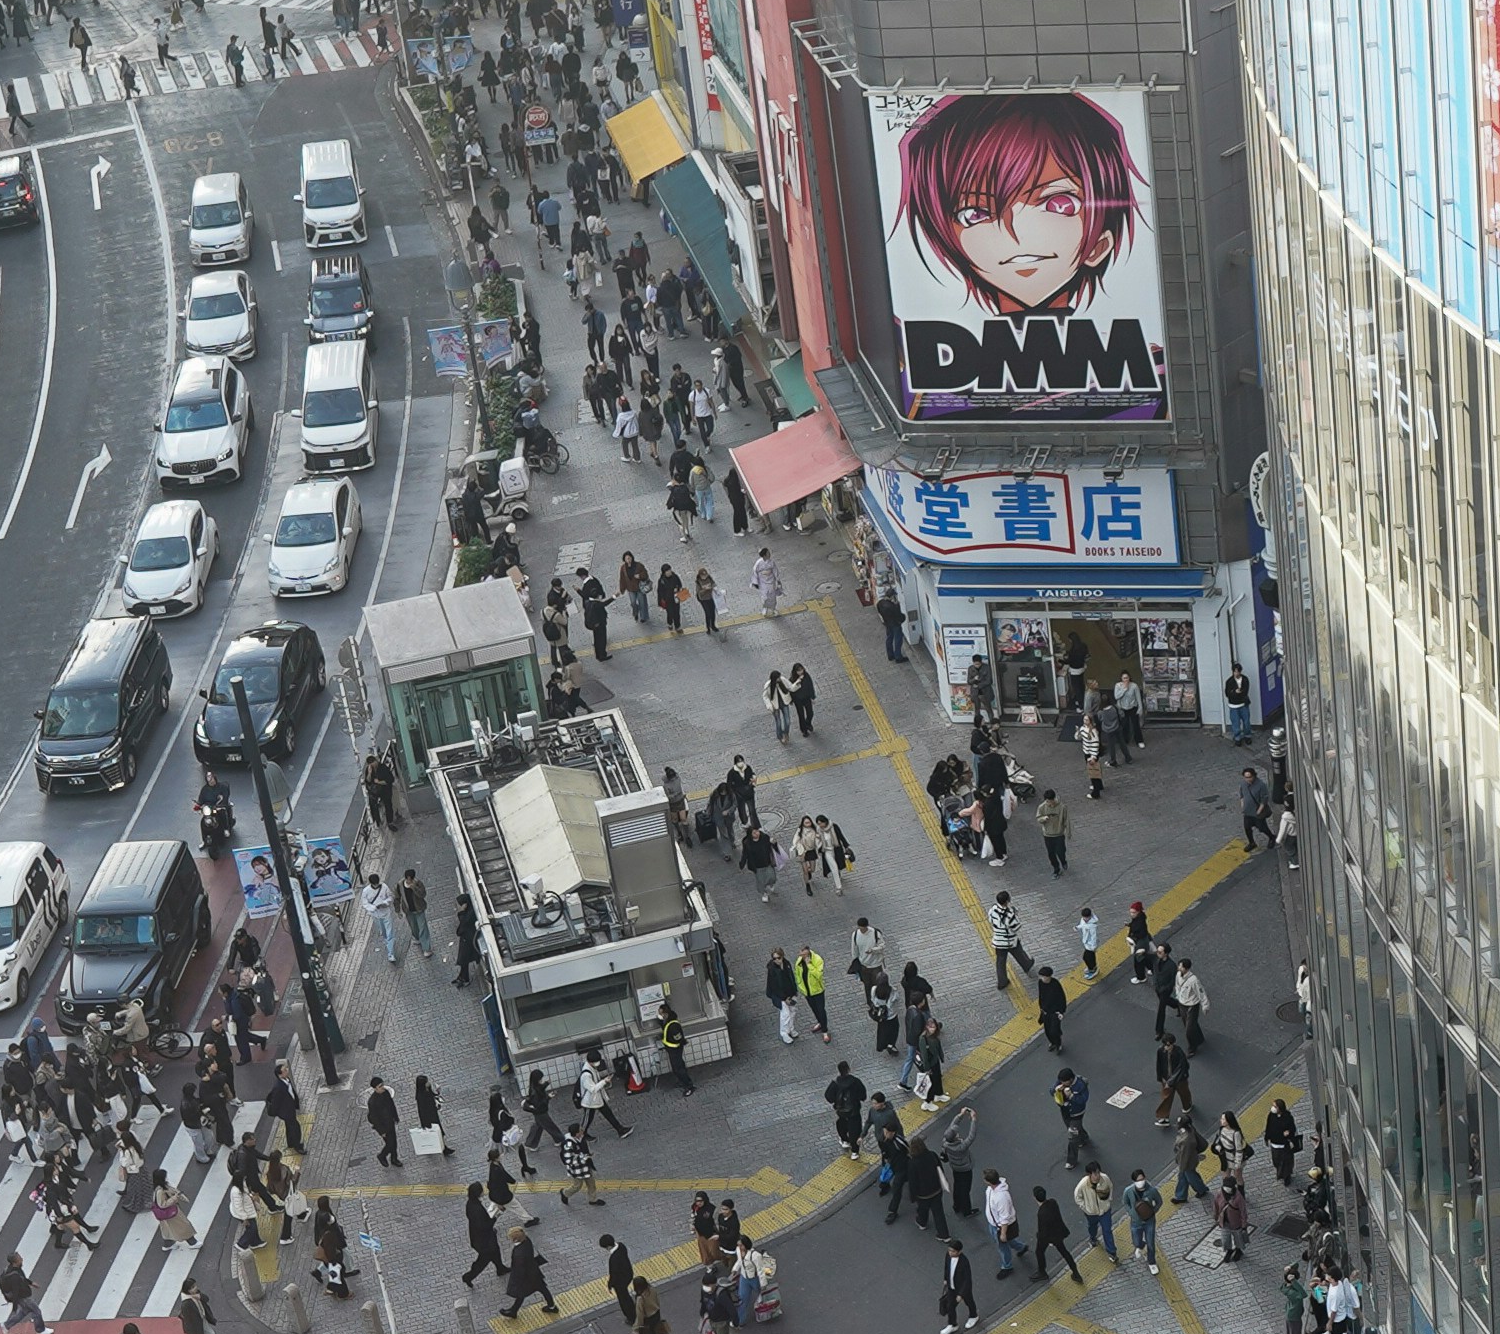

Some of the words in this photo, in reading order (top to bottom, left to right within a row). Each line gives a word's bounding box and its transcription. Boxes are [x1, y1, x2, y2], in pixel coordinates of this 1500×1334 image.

[902, 317, 1163, 391] DMM
[1084, 546, 1116, 558] BOOKS
[1119, 545, 1163, 558] TAISEIDO
[1035, 588, 1105, 598] TAISEIDO
